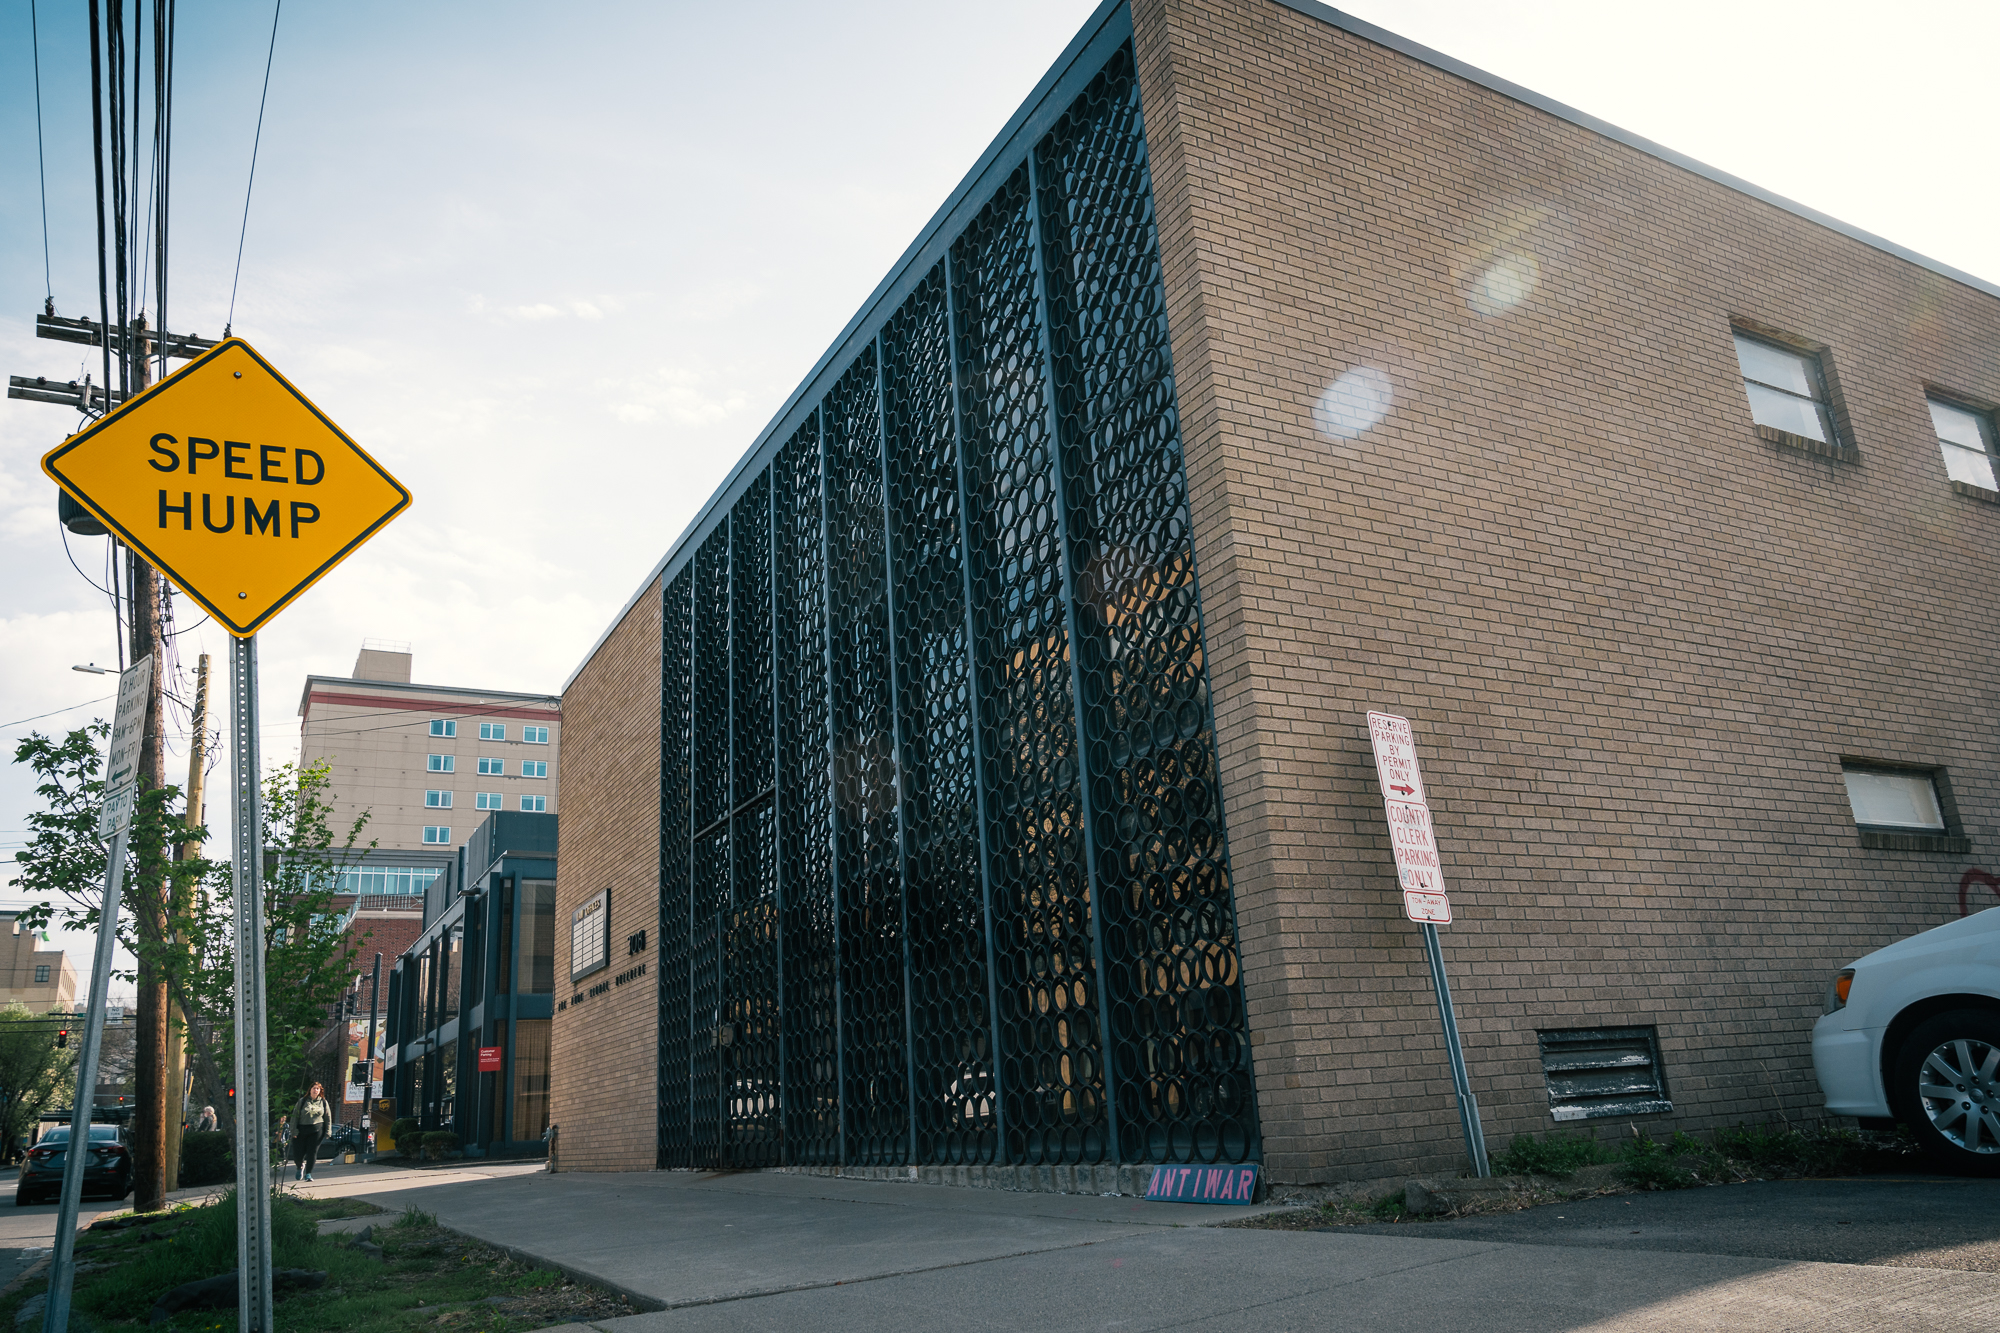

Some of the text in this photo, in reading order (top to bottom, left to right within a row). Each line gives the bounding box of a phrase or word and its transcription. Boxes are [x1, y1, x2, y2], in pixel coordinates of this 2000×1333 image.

[148, 433, 325, 485] SPEED
[158, 490, 321, 538] HUMP
[122, 669, 146, 696] 2 HOUR
[117, 691, 144, 719] PARKING
[113, 713, 144, 742] 9AM-6PM
[1371, 717, 1408, 734] RESERVE
[1375, 730, 1410, 746] PARKING
[110, 740, 138, 768] MON-FRI
[1389, 744, 1399, 756] BY
[1382, 755, 1411, 770] PERMIT
[1389, 768, 1409, 782] ONLY
[106, 795, 127, 815] PAY TO
[107, 812, 124, 831] PARK
[1390, 805, 1426, 826] COUNTY
[1396, 826, 1429, 846] CLERK
[1397, 847, 1436, 868] PARKING
[1408, 869, 1433, 888] ONLY
[1421, 908, 1436, 916] ZONE
[1147, 1168, 1253, 1200] ANTIWAR
